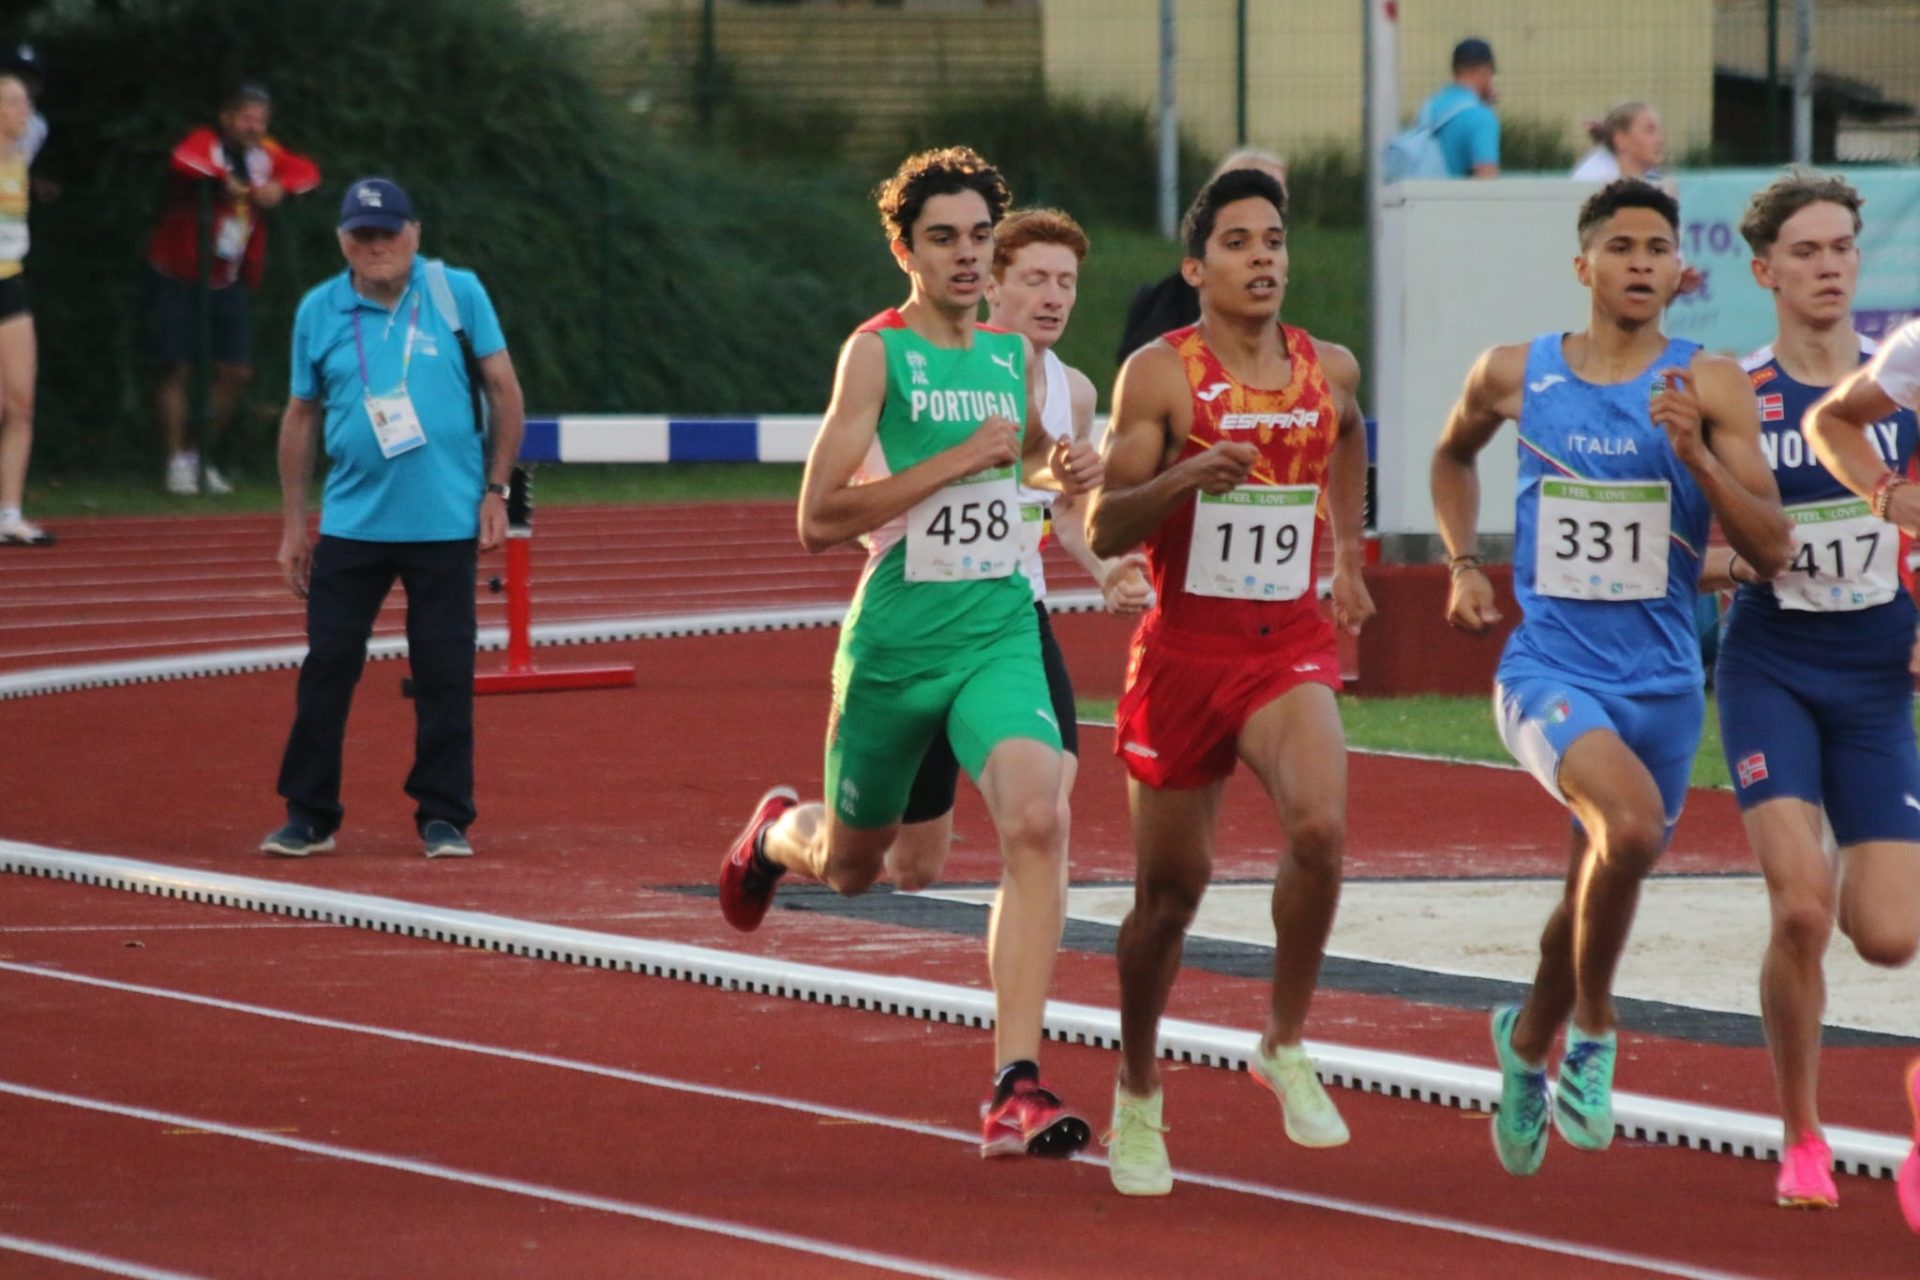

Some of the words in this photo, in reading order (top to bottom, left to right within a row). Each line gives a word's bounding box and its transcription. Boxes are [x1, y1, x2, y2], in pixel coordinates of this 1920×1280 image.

[1686, 222, 1742, 258] TO,
[911, 389, 1021, 424] PORTUGAL
[1219, 408, 1319, 430] ESPAÑA
[1568, 434, 1638, 455] ITALIA
[926, 499, 1009, 546] 458
[1555, 517, 1642, 564] 331
[1217, 522, 1299, 566] 119
[1790, 531, 1879, 579] 417
